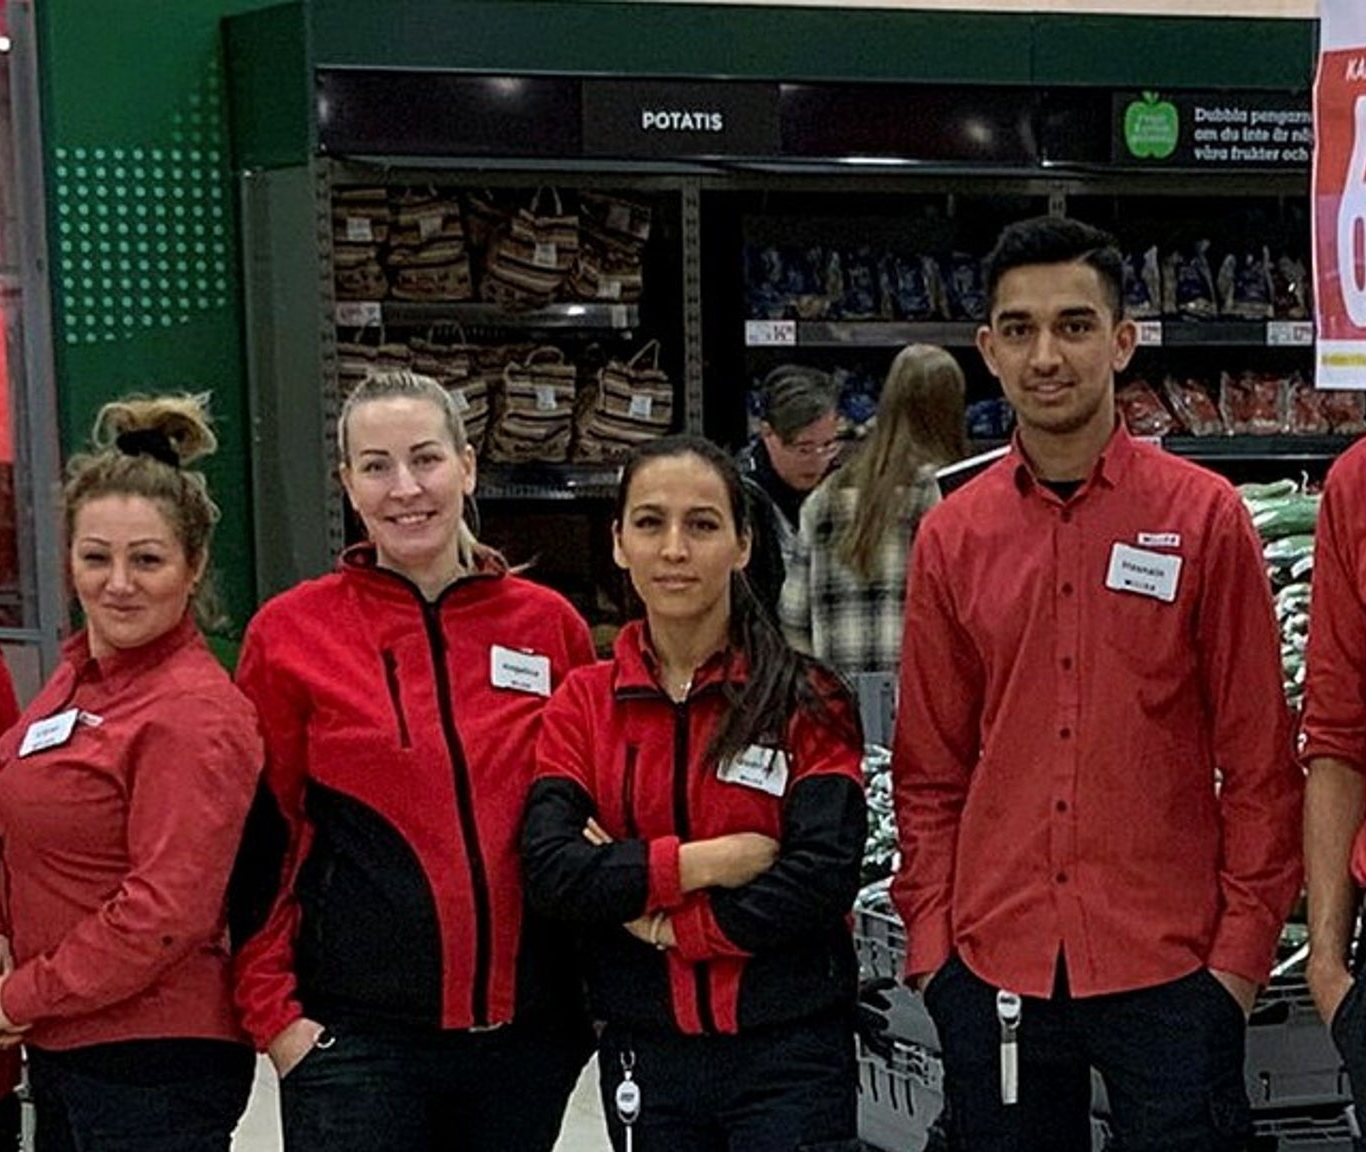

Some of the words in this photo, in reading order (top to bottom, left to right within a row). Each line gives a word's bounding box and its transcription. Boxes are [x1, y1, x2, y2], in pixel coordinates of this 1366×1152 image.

[642, 111, 723, 131] POTATIS
[1292, 128, 1312, 144] nö
[1282, 147, 1308, 161] och
